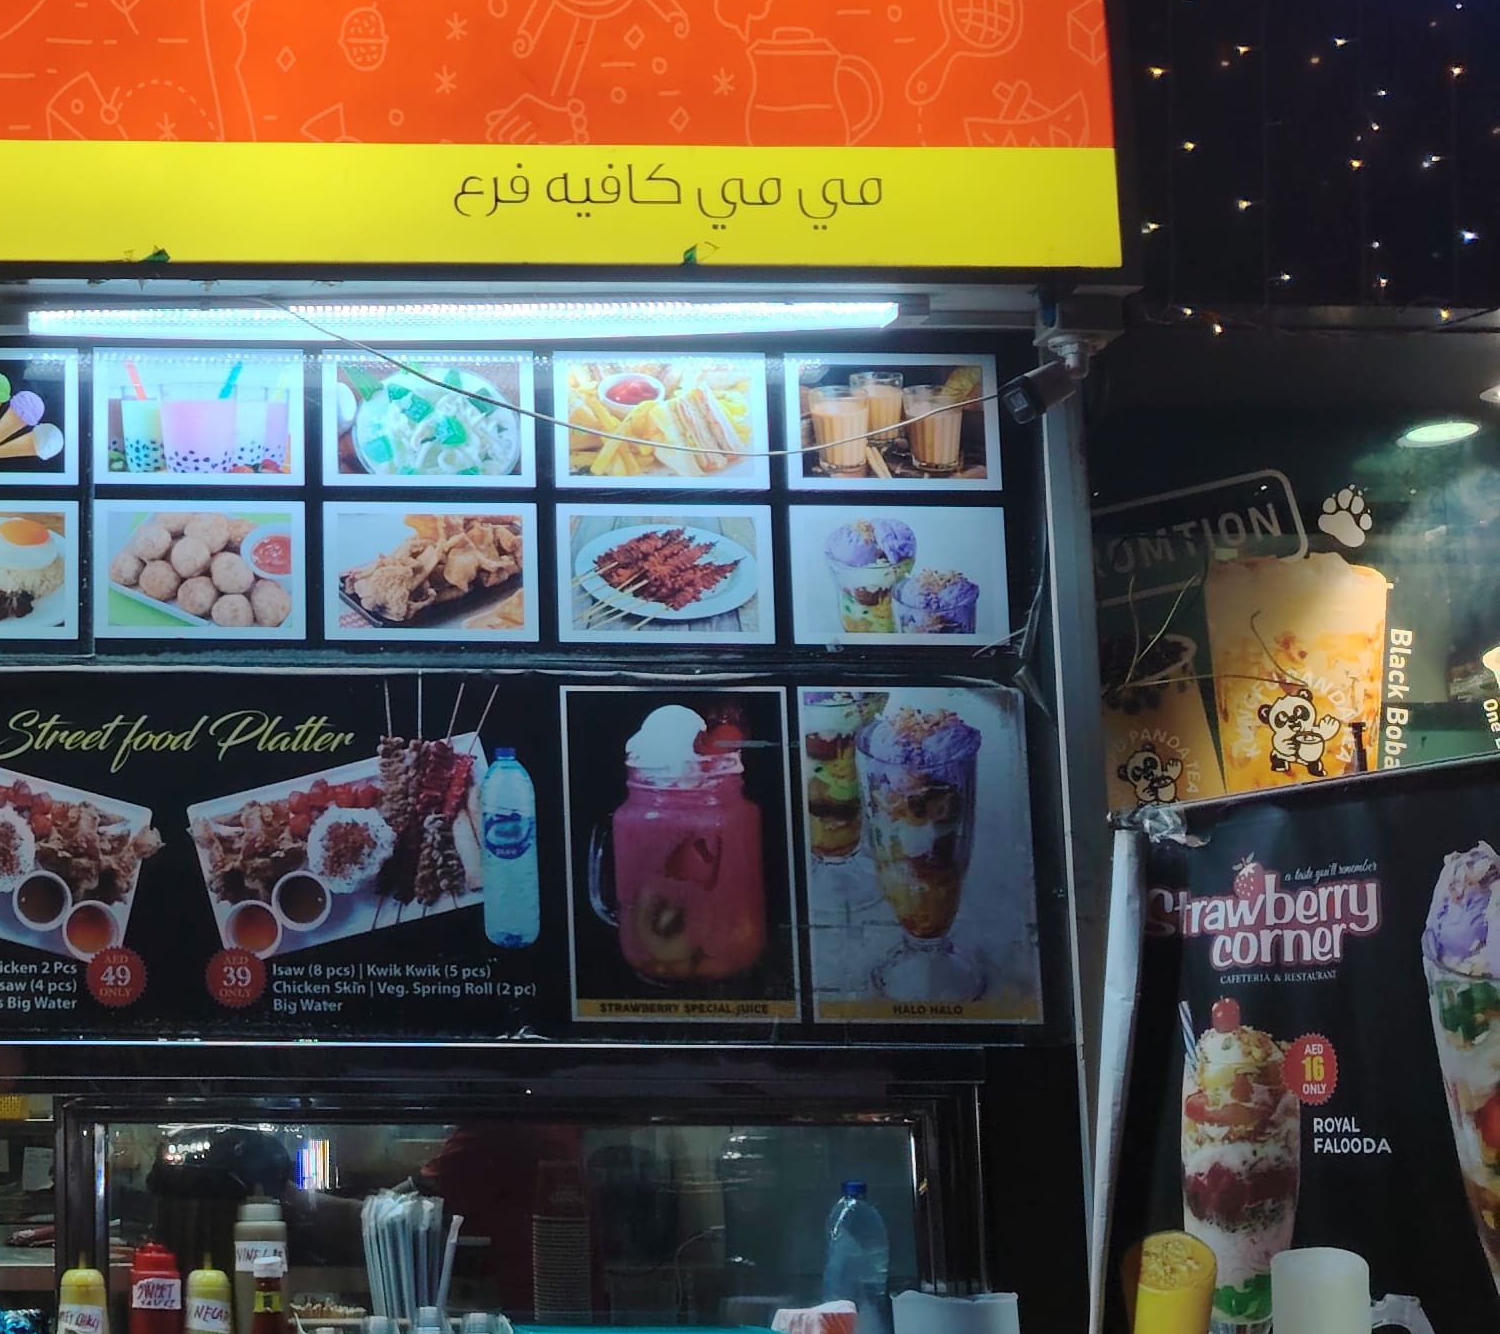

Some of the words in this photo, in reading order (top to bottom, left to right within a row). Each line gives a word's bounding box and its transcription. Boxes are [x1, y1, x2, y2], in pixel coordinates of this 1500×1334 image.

[453, 163, 530, 218] فرع
[546, 163, 683, 218] كافيه
[696, 177, 782, 231] مي
[797, 177, 883, 231] مي
[1387, 628, 1413, 700] Black
[109, 714, 209, 774] food
[208, 708, 355, 762] Platter
[1383, 706, 1409, 769] Boba
[1148, 873, 1379, 935] Strawberry
[1211, 924, 1349, 968] corner
[40, 961, 51, 975] 2
[53, 961, 78, 975] Pcs
[100, 965, 132, 988] 49
[222, 966, 252, 987] 39
[325, 965, 356, 979] pcs)
[367, 964, 403, 977] Kwik
[405, 964, 440, 977] Kwik
[461, 965, 491, 979] pcs)
[1219, 973, 1271, 985] CAFETERIA
[1283, 970, 1338, 982] RESTAURANT
[47, 978, 78, 994] pcs)
[272, 980, 331, 995] Chicken
[333, 980, 366, 995] Skin
[377, 981, 410, 998] Veg.
[412, 981, 462, 998] Spring
[464, 981, 493, 995] Roll
[496, 982, 511, 998] (2
[513, 983, 538, 999] pc)
[7, 995, 32, 1012] Big
[34, 995, 78, 1010] Water
[272, 999, 297, 1014] Big
[300, 999, 344, 1013] Water
[600, 1002, 680, 1015] STRAWBERRY
[1303, 1043, 1324, 1055] AED
[1302, 1055, 1325, 1081] 16
[1302, 1082, 1327, 1095] ONLY
[1312, 1116, 1361, 1134] ROYAL
[1313, 1137, 1393, 1154] FALOODA
